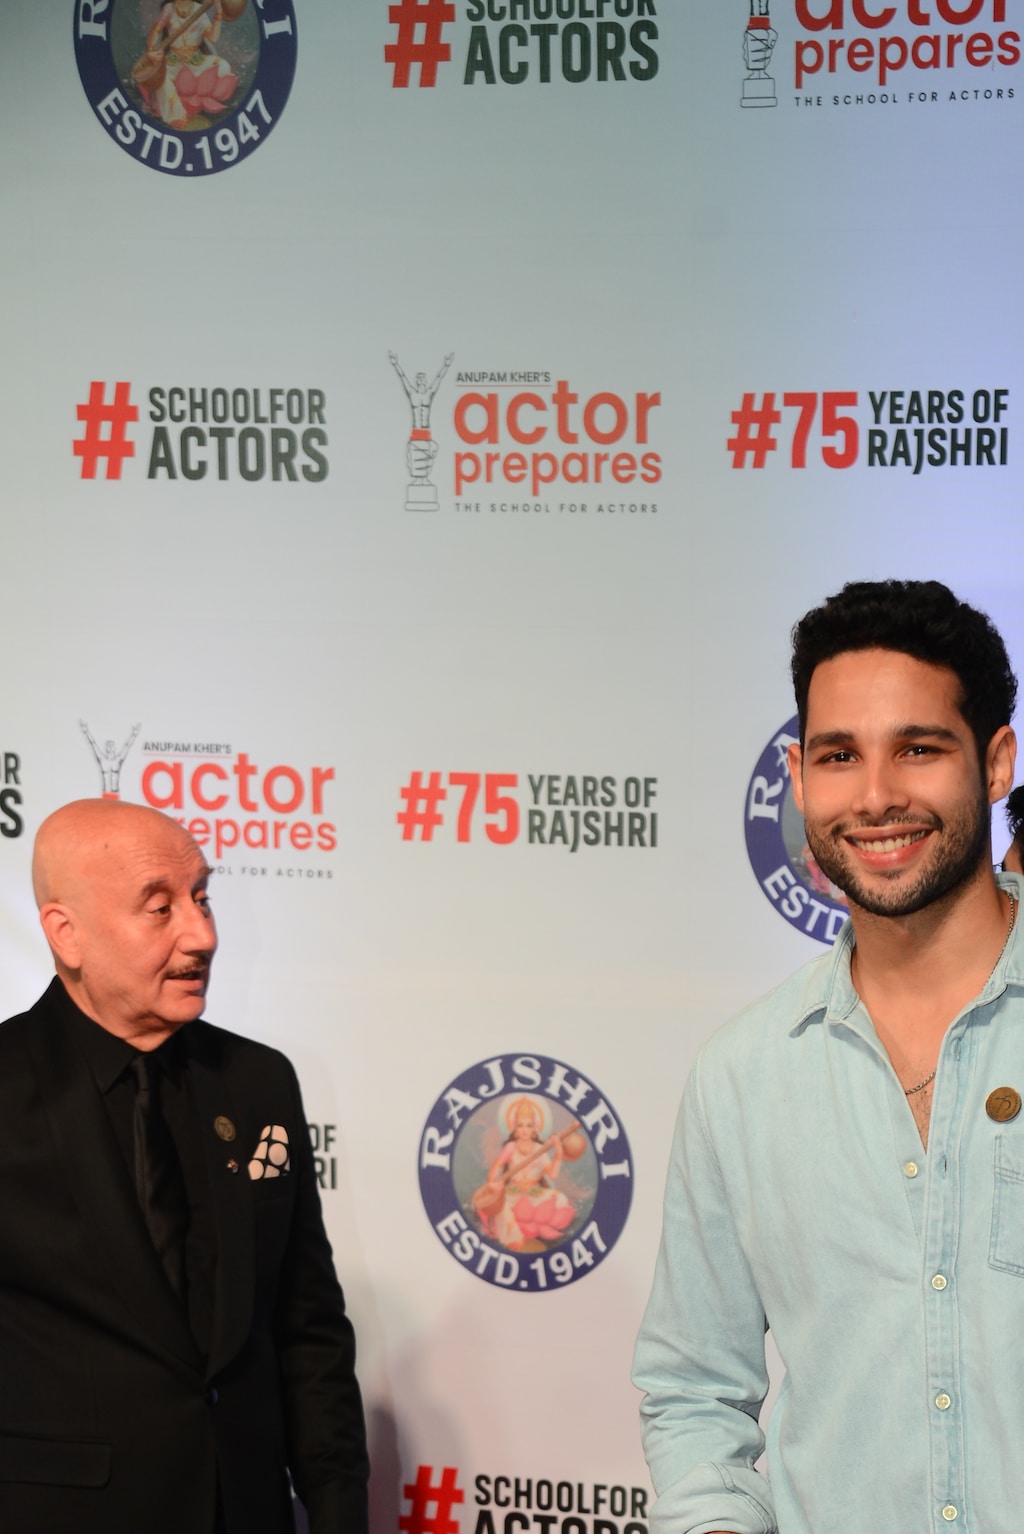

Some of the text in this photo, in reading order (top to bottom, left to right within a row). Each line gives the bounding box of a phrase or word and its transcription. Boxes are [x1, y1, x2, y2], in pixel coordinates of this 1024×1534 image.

[463, 20, 660, 85] ACTORS
[795, 31, 1021, 89] prepares
[795, 88, 1016, 107] THE SCHOOL FOR ACTORS
[97, 88, 272, 171] ESTD.1947
[456, 372, 551, 383] ANUPAM KHER'S
[453, 380, 662, 445] actor
[727, 389, 1009, 469] #75 YEARS OF
[147, 426, 330, 483] ACTORS
[454, 452, 663, 497] prepares
[868, 427, 1009, 475] RAJSHRI
[455, 503, 658, 514] THE SCHOOL FOR ACTORS
[144, 741, 191, 753] ANUPAM
[141, 753, 336, 815] actor
[396, 770, 658, 846] #75 YEARS OF
[174, 817, 337, 859] epares
[528, 809, 658, 853] RAJSHRI
[422, 1056, 630, 1181] RAJSHRI
[436, 1210, 608, 1288] ESTD.1947
